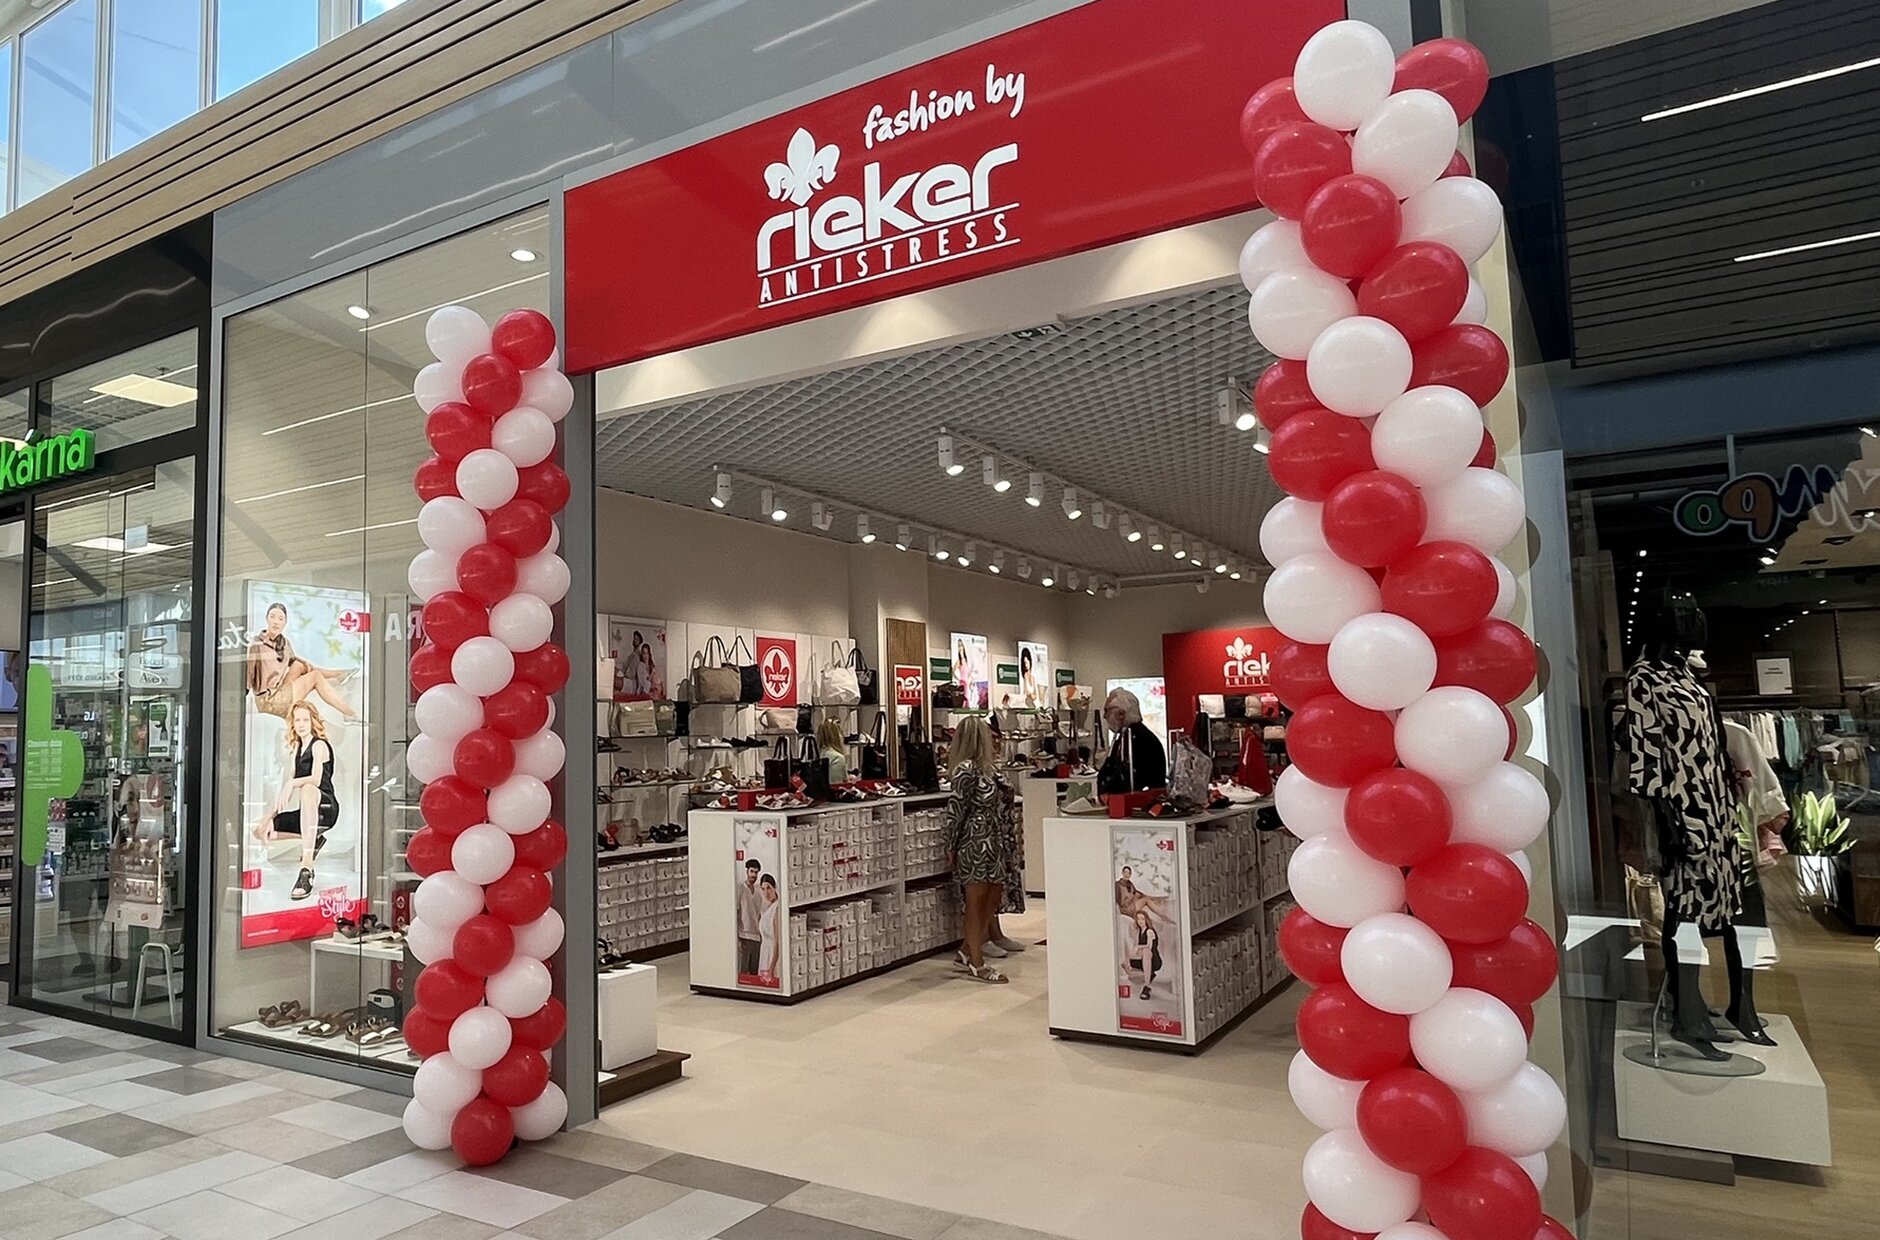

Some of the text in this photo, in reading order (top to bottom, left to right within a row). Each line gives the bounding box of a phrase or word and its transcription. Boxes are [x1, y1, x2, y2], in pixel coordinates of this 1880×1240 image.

[863, 63, 1026, 149] fashion by
[757, 142, 1019, 272] rieker
[760, 213, 1008, 303] ANTISTRESS
[318, 893, 356, 923] Style
